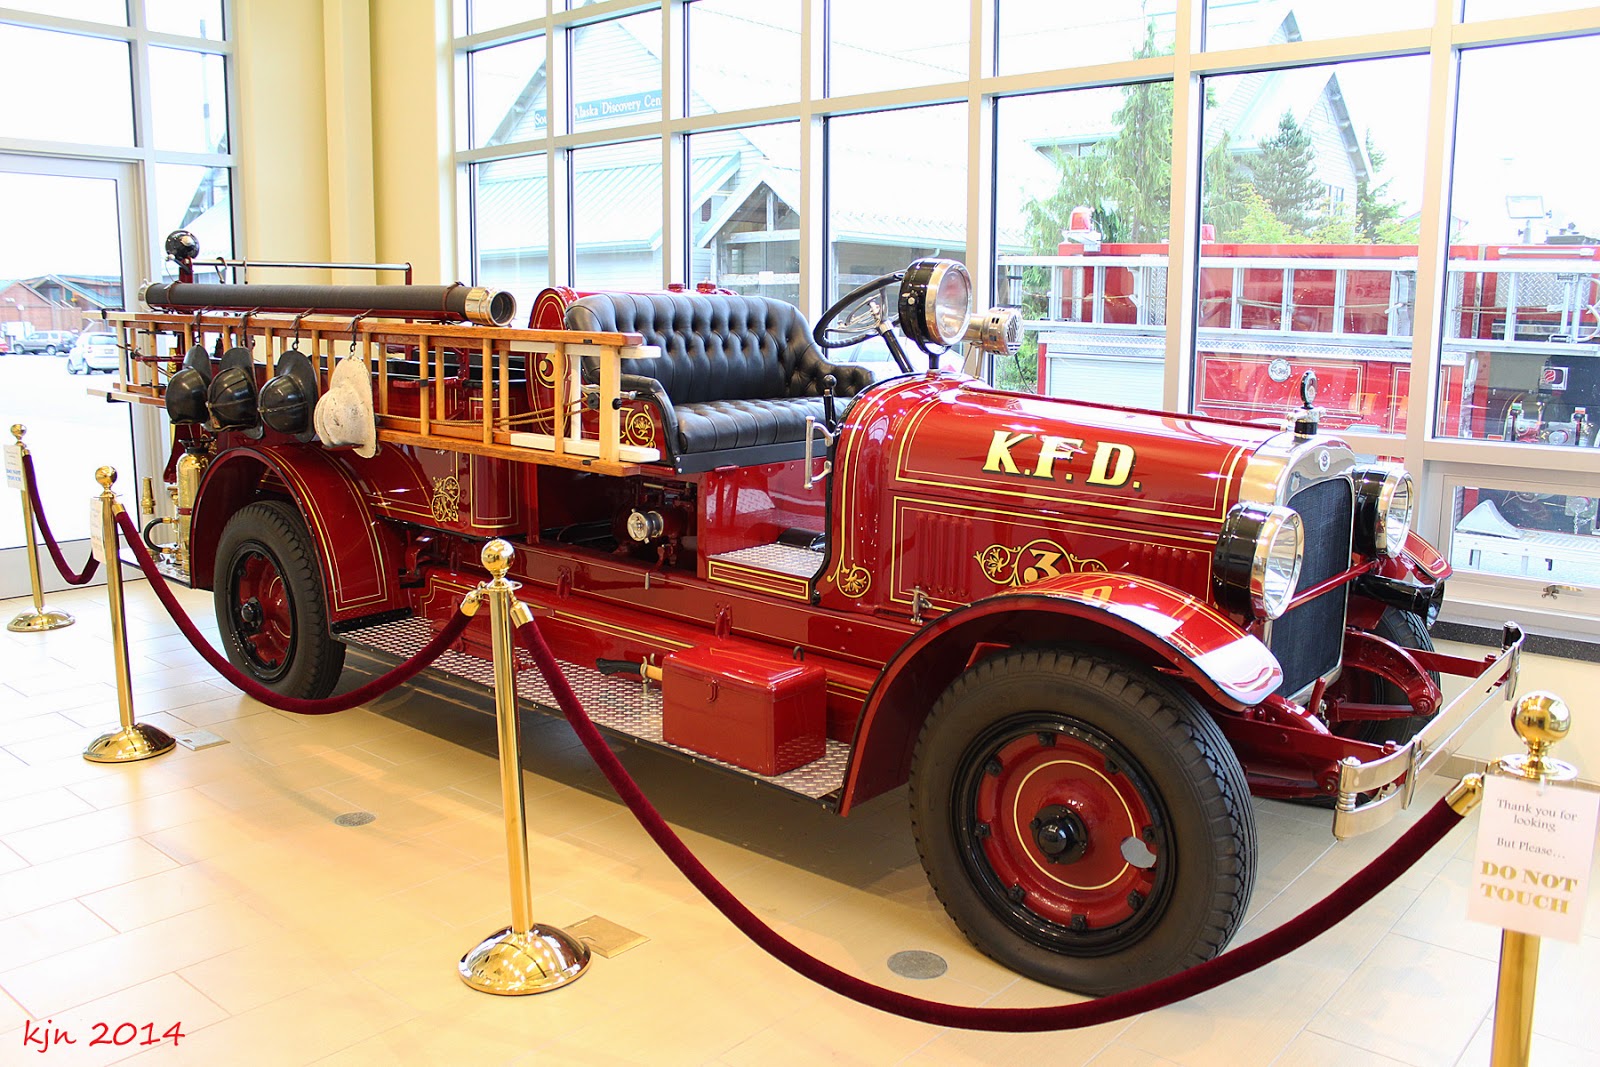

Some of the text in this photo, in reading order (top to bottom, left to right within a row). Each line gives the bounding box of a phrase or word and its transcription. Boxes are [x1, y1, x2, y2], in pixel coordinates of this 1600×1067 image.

[601, 99, 641, 115] Discovery
[1023, 547, 1064, 584] 3
[1497, 798, 1578, 822] Thank you for
[1513, 814, 1556, 833] looking
[1496, 837, 1515, 849] But
[1480, 860, 1578, 894] DO NOT
[1480, 883, 1569, 914] TOUCH
